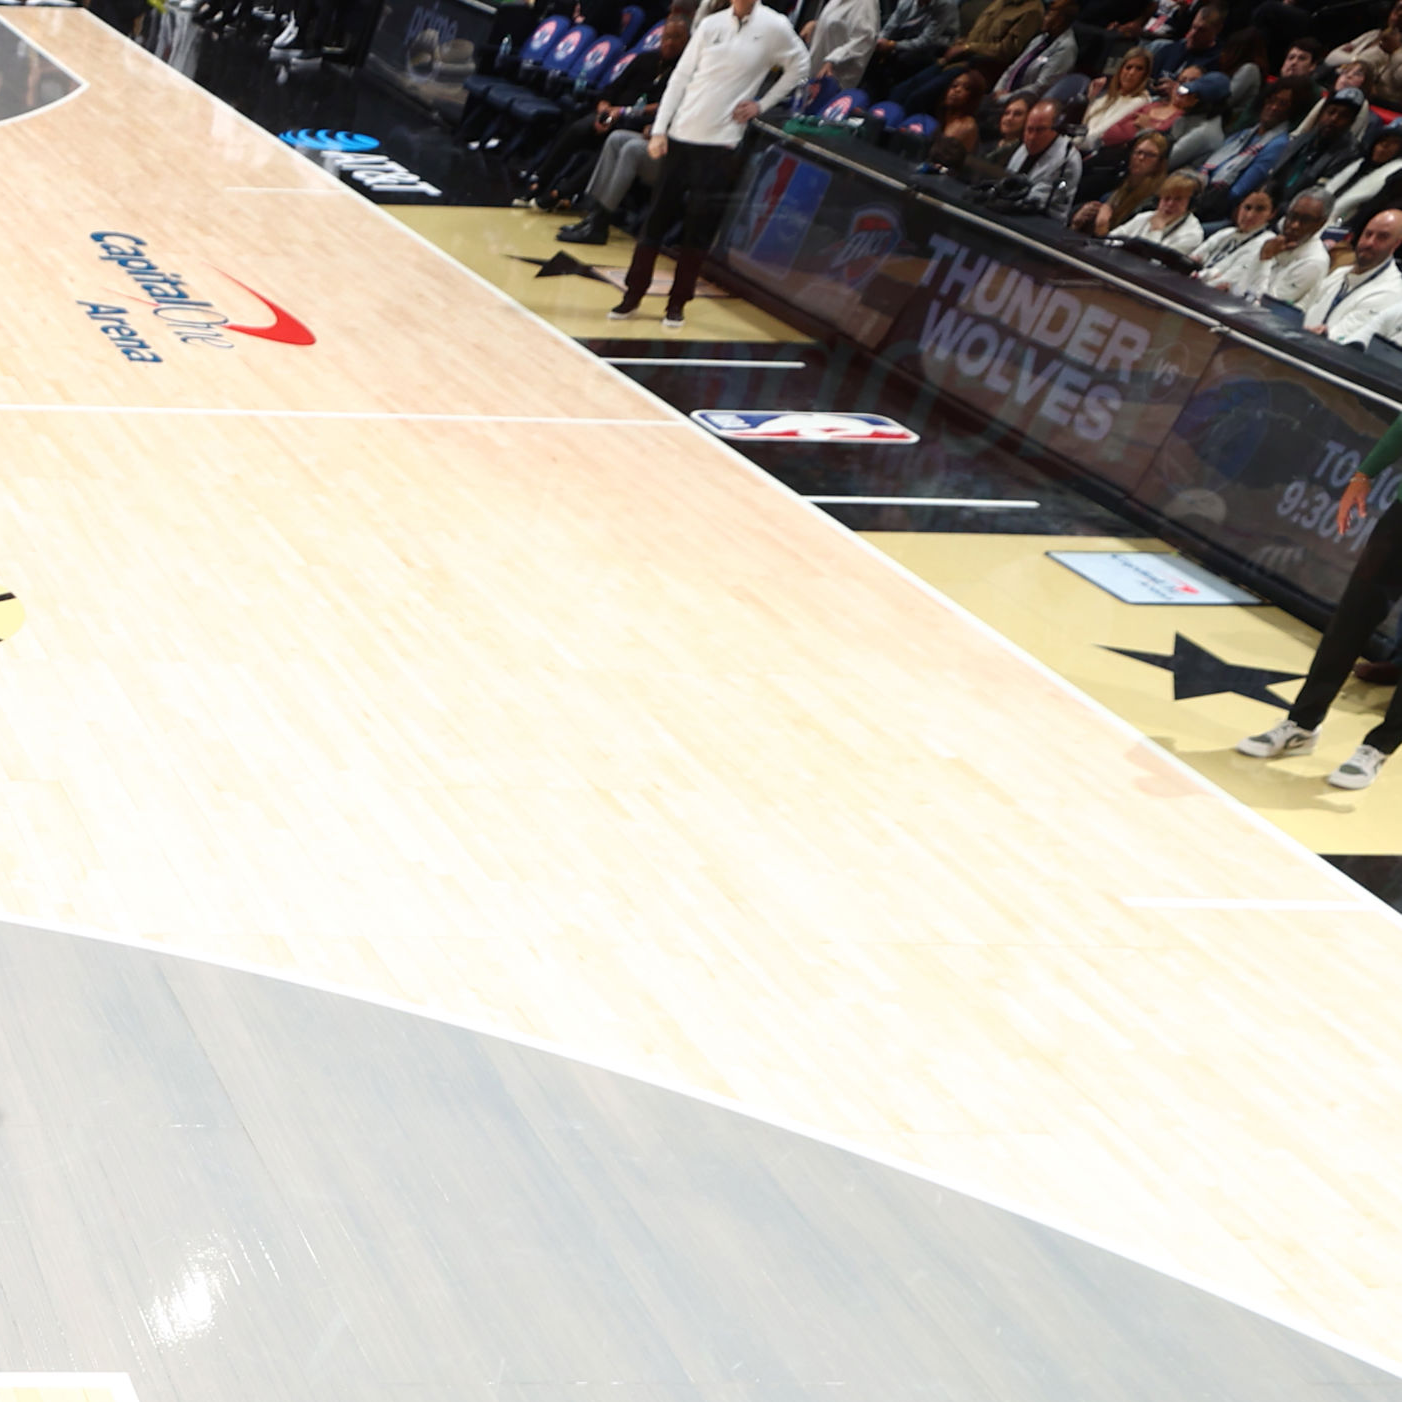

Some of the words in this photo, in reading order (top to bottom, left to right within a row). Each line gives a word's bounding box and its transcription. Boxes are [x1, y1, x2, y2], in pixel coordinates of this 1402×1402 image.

[321, 151, 443, 197] AT&T
[76, 300, 164, 363] Arena
[90, 231, 213, 307] Capital
[153, 306, 235, 349] One
[919, 233, 1151, 384] THUNDER
[918, 302, 1121, 441] WOLVES
